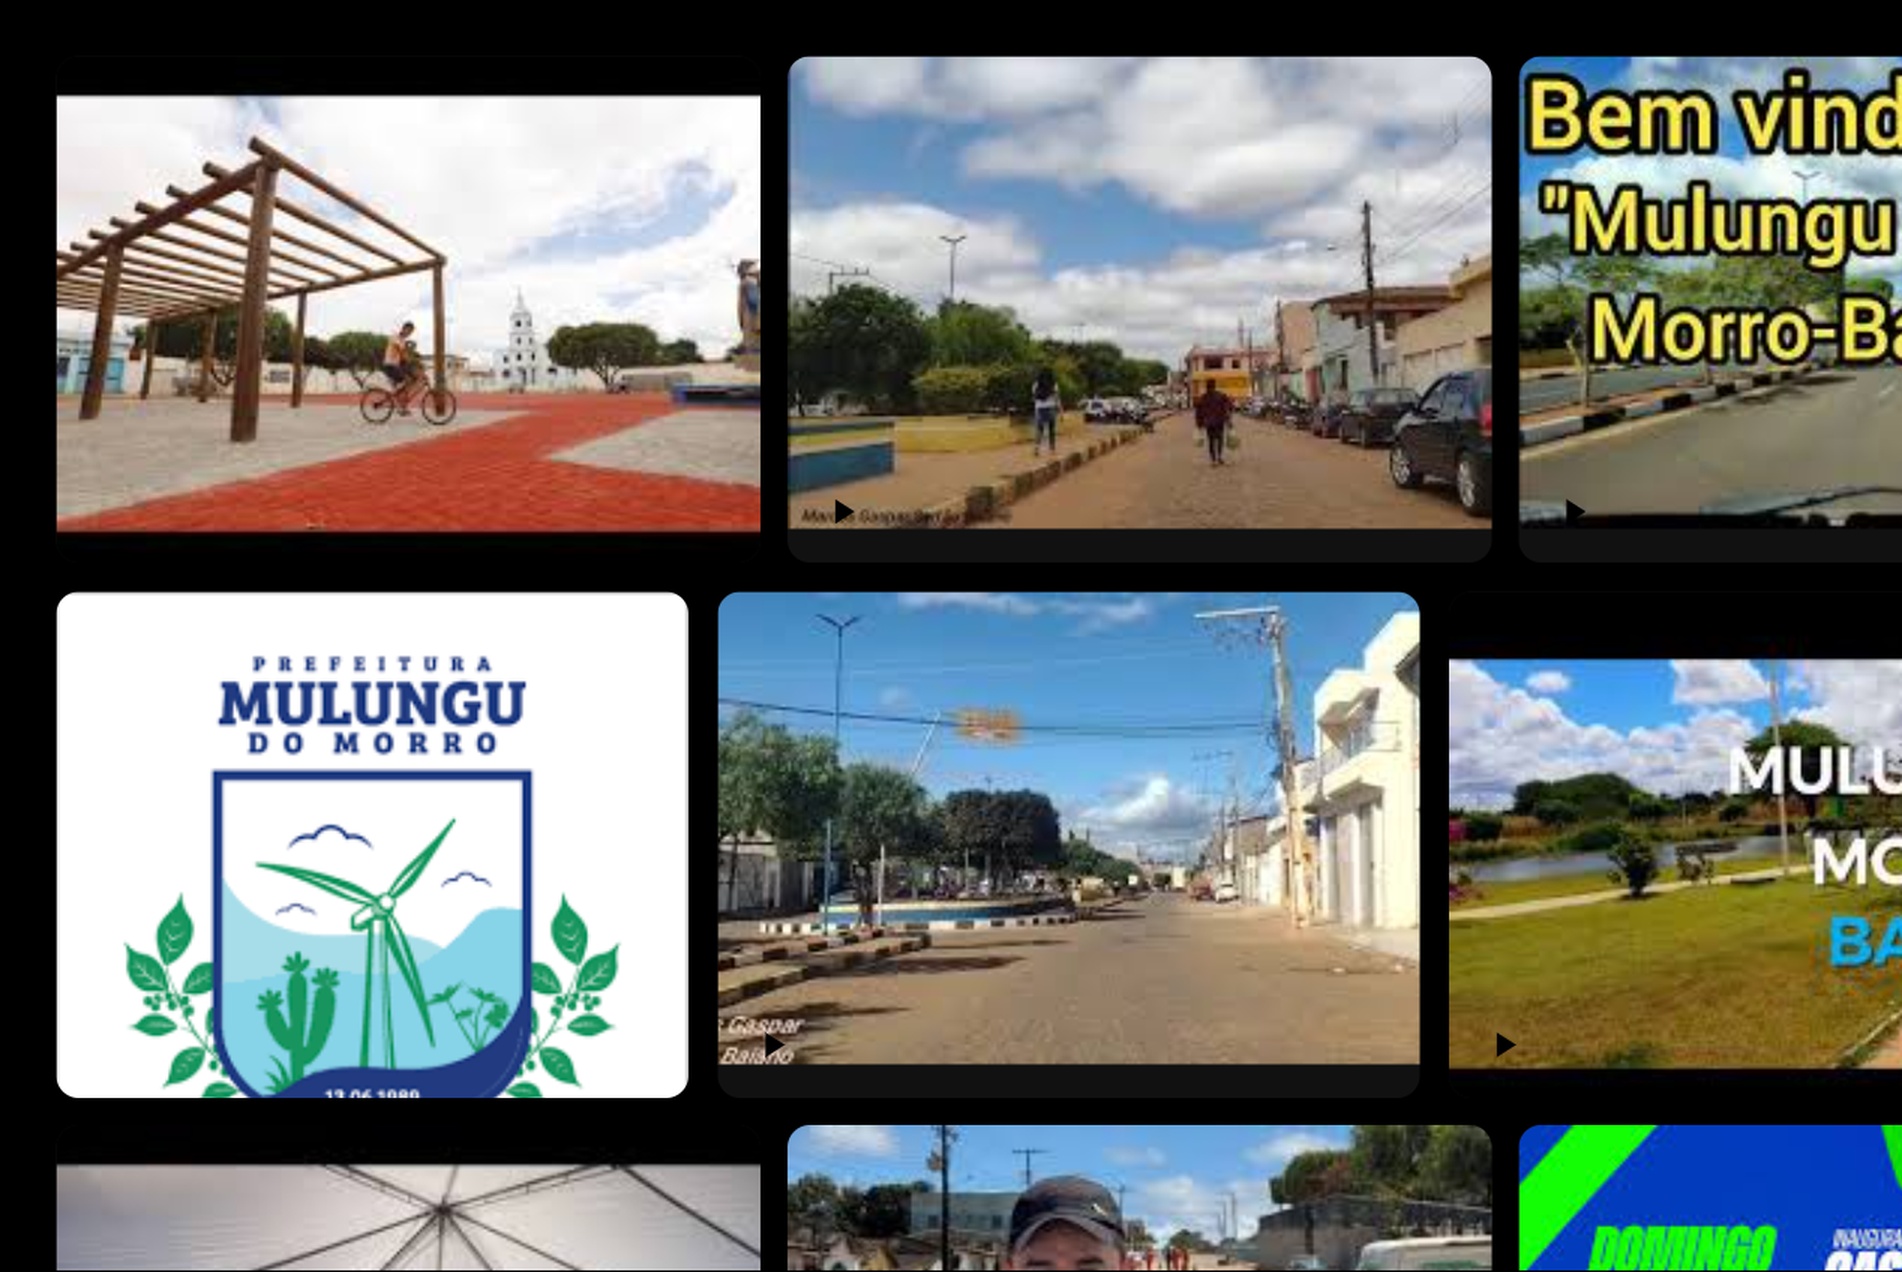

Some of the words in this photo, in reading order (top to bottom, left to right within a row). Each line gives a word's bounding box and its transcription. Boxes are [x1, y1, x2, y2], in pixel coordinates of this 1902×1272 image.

[252, 655, 493, 672] PREFEITURA
[218, 680, 527, 726] MULUNGU
[248, 731, 304, 755] DO
[333, 731, 497, 755] MORRO
[1588, 1224, 1778, 1271] DOMINGO
